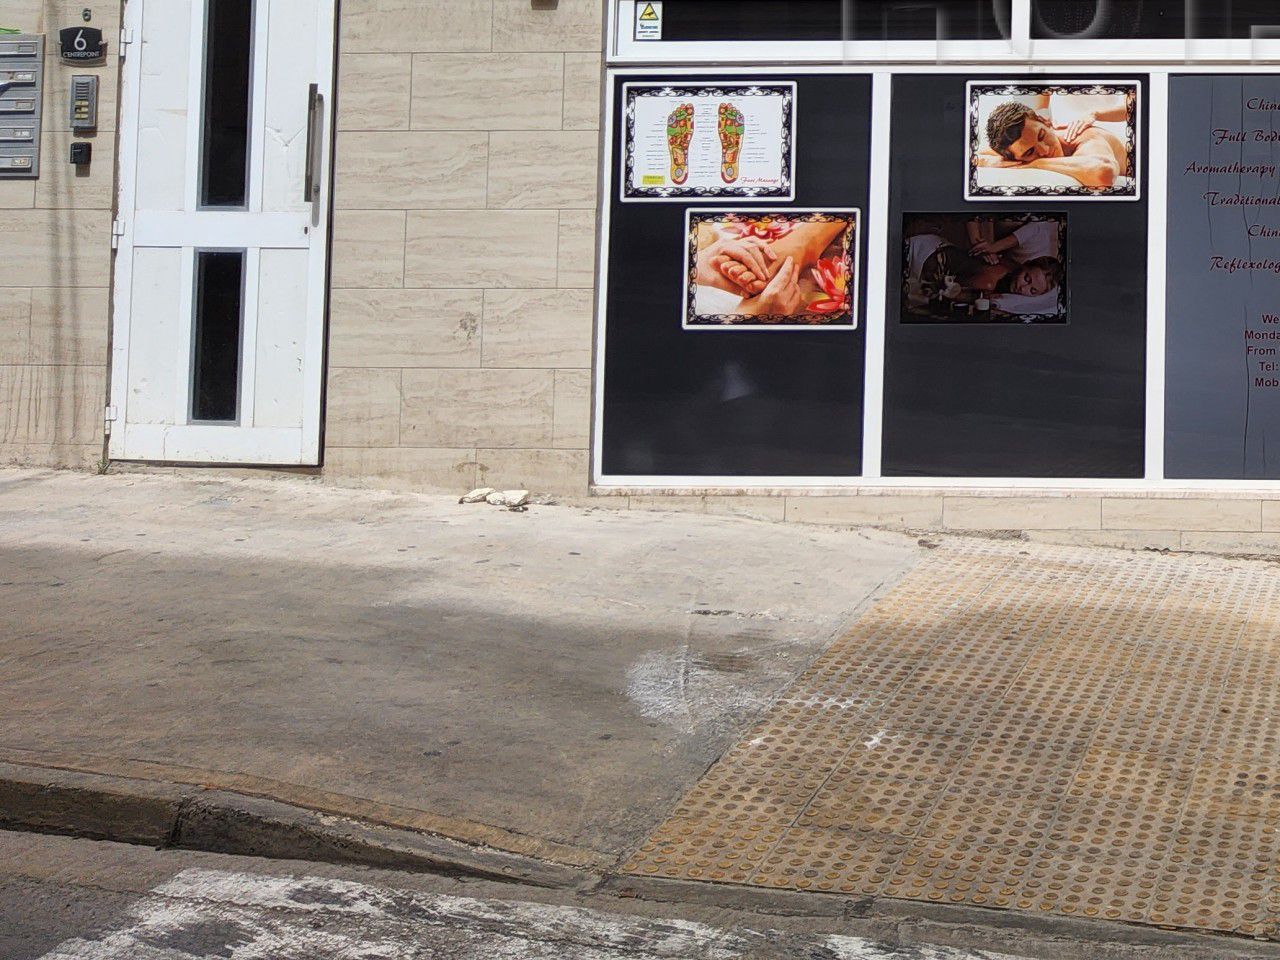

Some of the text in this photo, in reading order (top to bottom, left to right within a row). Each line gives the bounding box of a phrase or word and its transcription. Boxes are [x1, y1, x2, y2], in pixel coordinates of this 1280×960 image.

[74, 29, 87, 51] 6
[1212, 129, 1247, 145] Full
[1184, 161, 1275, 178] Aromatherapy
[1203, 192, 1280, 206] Traditional
[1262, 315, 1280, 324] We
[1247, 346, 1276, 356] From
[1259, 362, 1279, 372] Tel:
